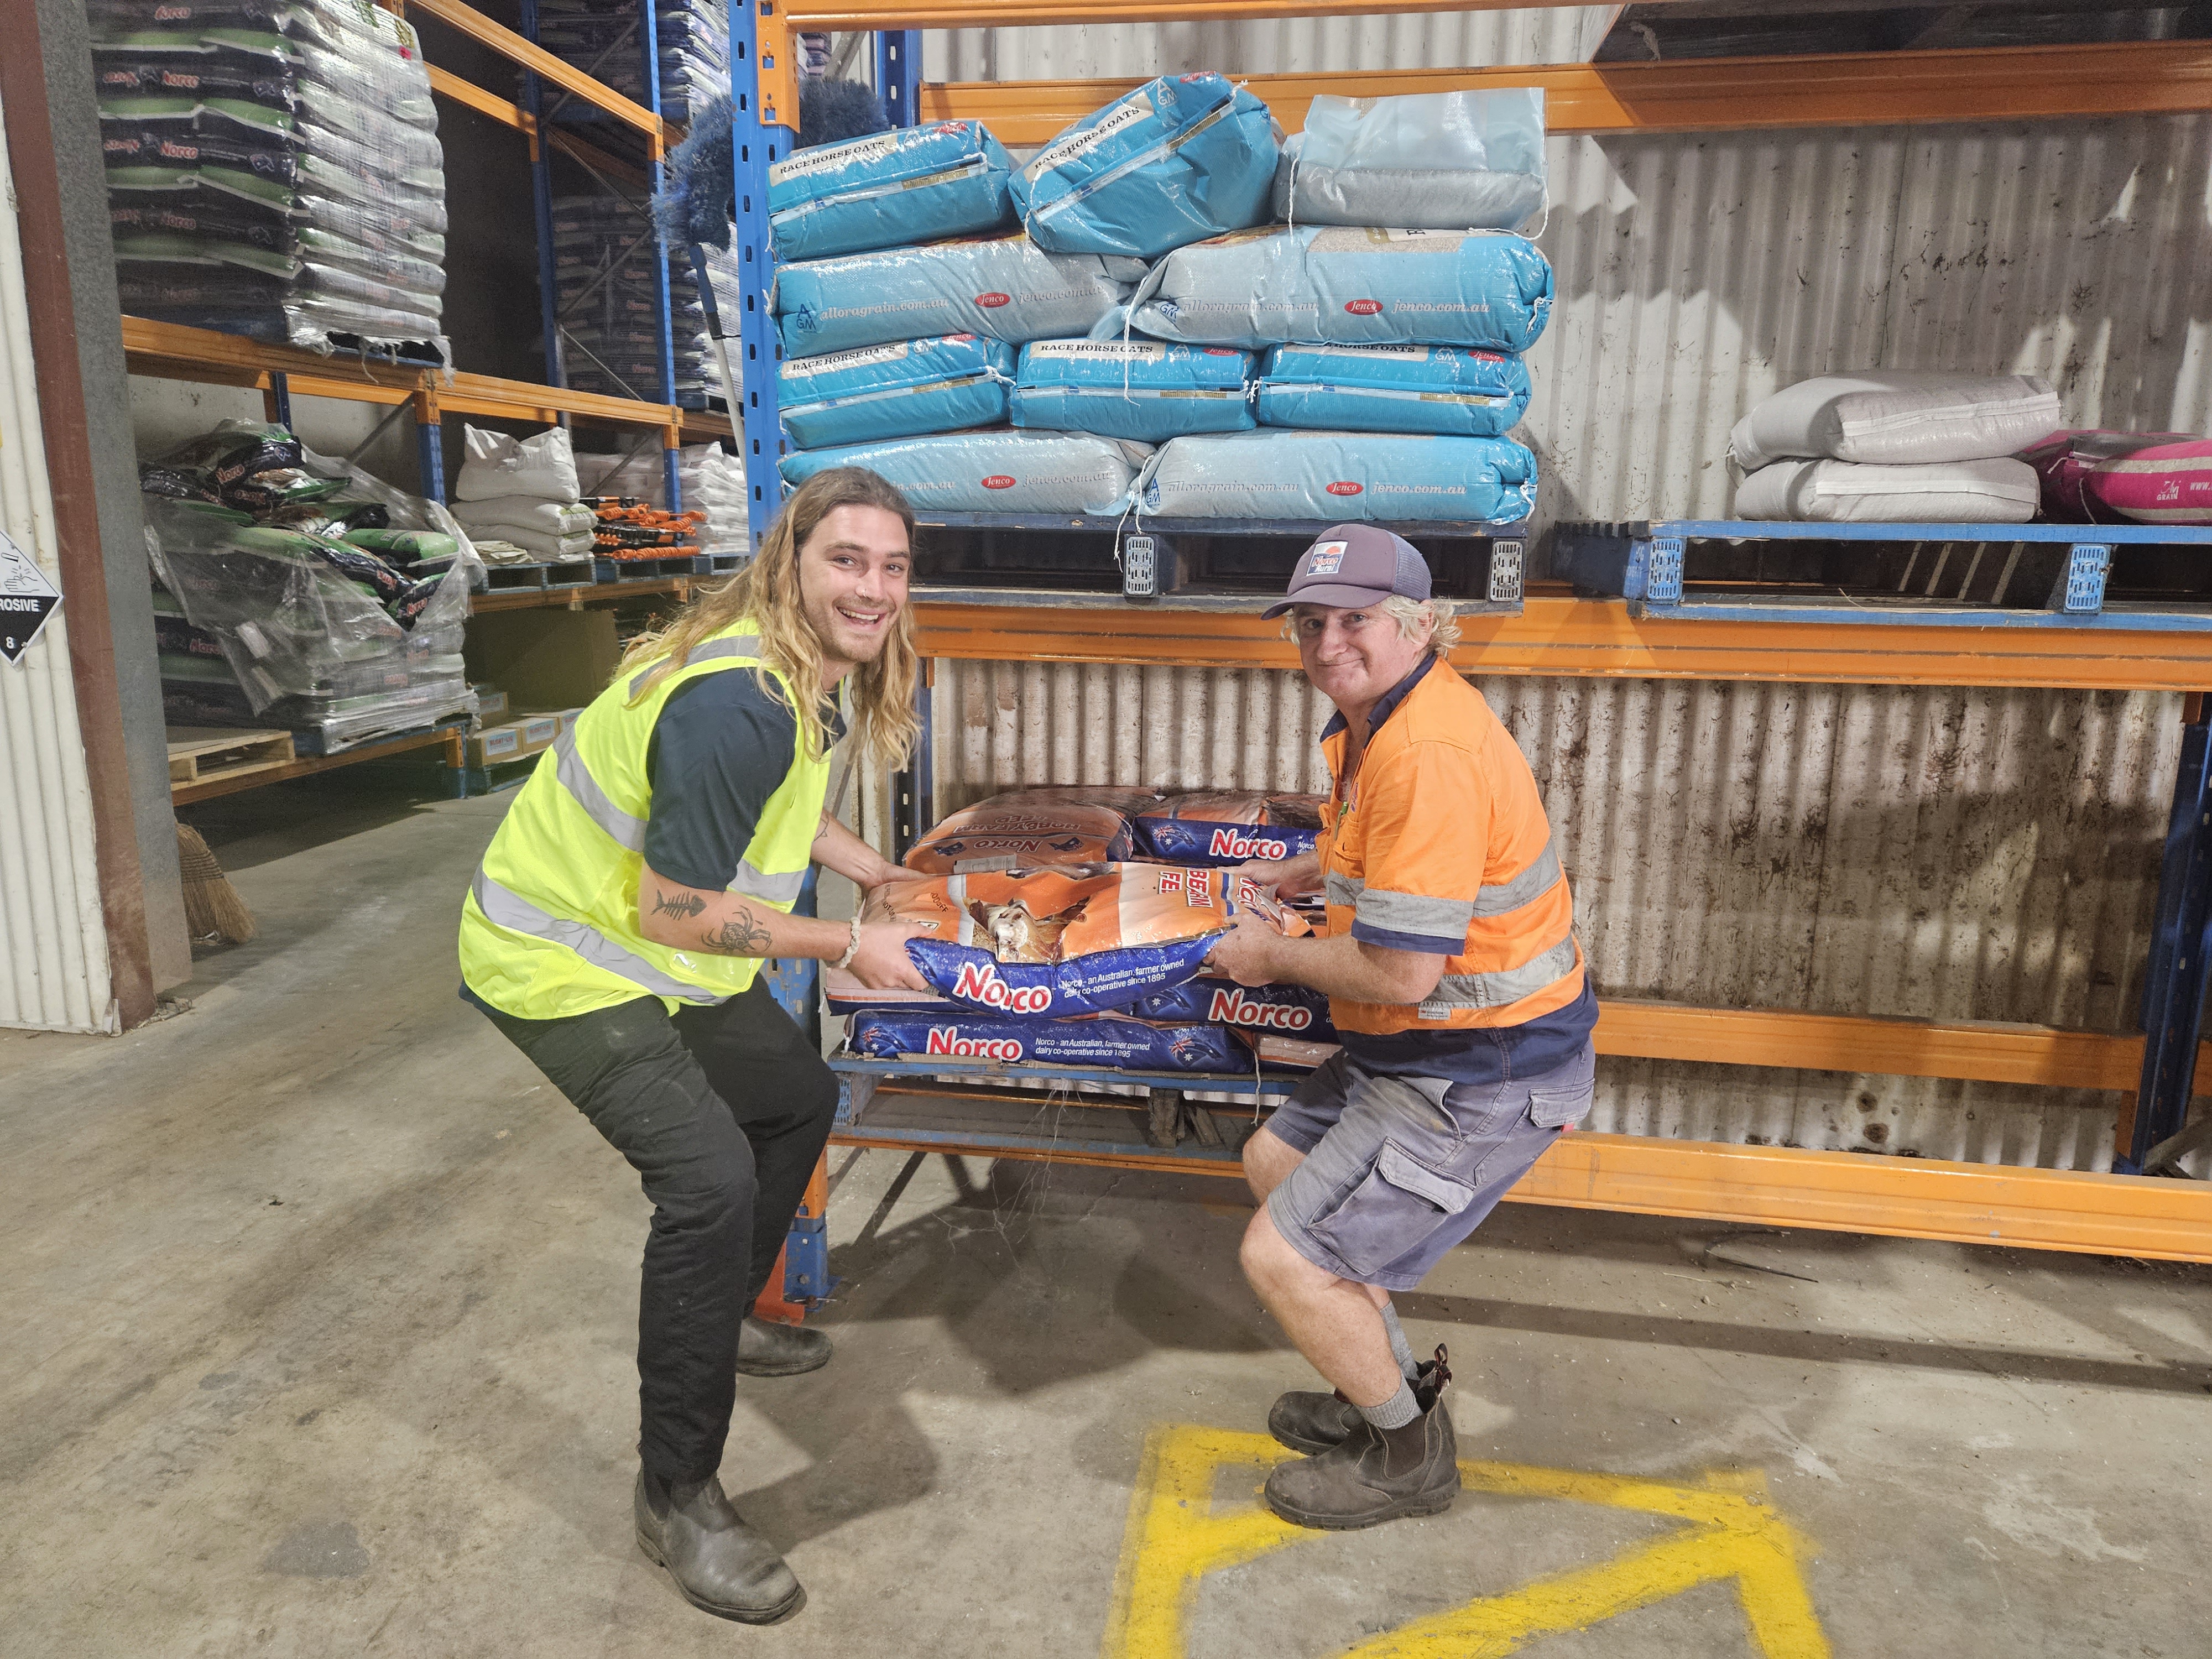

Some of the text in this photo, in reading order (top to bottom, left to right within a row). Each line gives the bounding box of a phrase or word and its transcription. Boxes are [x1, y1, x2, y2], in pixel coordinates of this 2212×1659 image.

[1035, 106, 1140, 169] RACE HORSE OATS
[160, 140, 199, 159] Norco
[780, 140, 885, 175] RACE HORSE OATS
[980, 293, 1005, 305] Jenco
[797, 304, 812, 319] A
[1351, 301, 1378, 313] Jenco
[1393, 299, 1491, 315] jenco.com.au
[796, 319, 817, 330] GM
[1382, 345, 1416, 353] OATS
[1475, 350, 1500, 359] Jenco
[792, 344, 896, 371] RACE HORSE OATS
[1434, 352, 1455, 362] GM
[216, 464, 245, 483] Norco
[987, 477, 1011, 487] Jenco
[1023, 471, 1110, 488] jenco.com.au
[1149, 478, 1159, 494] A
[1332, 482, 1358, 493] Jenco
[1371, 481, 1468, 496] jenco.com.au
[2190, 482, 2212, 491] www.
[1146, 492, 1161, 504] GM
[1311, 555, 1339, 567] Norco
[1314, 564, 1335, 572] Rural
[6, 637, 15, 649] 8
[953, 821, 1081, 833] HOBBY FARM
[973, 838, 1044, 853] Norco
[1209, 828, 1287, 860] Norco
[1297, 841, 1314, 849] Norco
[1159, 871, 1183, 894] FE
[1062, 979, 1083, 989] Norco
[1088, 975, 1098, 984] an
[1098, 969, 1134, 983] Australian,
[1135, 966, 1160, 978] farmer
[1161, 958, 1185, 972] owned
[952, 962, 1052, 1014] Norco
[1082, 980, 1126, 995] co-operative
[1127, 976, 1146, 987] since
[1147, 972, 1166, 983] 1895
[1208, 988, 1312, 1030] Norco
[926, 1026, 1024, 1061] Norco
[1035, 1037, 1055, 1046] Norco
[1069, 1037, 1104, 1048] Australian,
[1105, 1039, 1126, 1049] farmer
[1128, 1042, 1151, 1051] owned
[1035, 1046, 1052, 1056] dairy
[1052, 1047, 1094, 1057] co-operative
[1114, 1050, 1131, 1058] 1895
